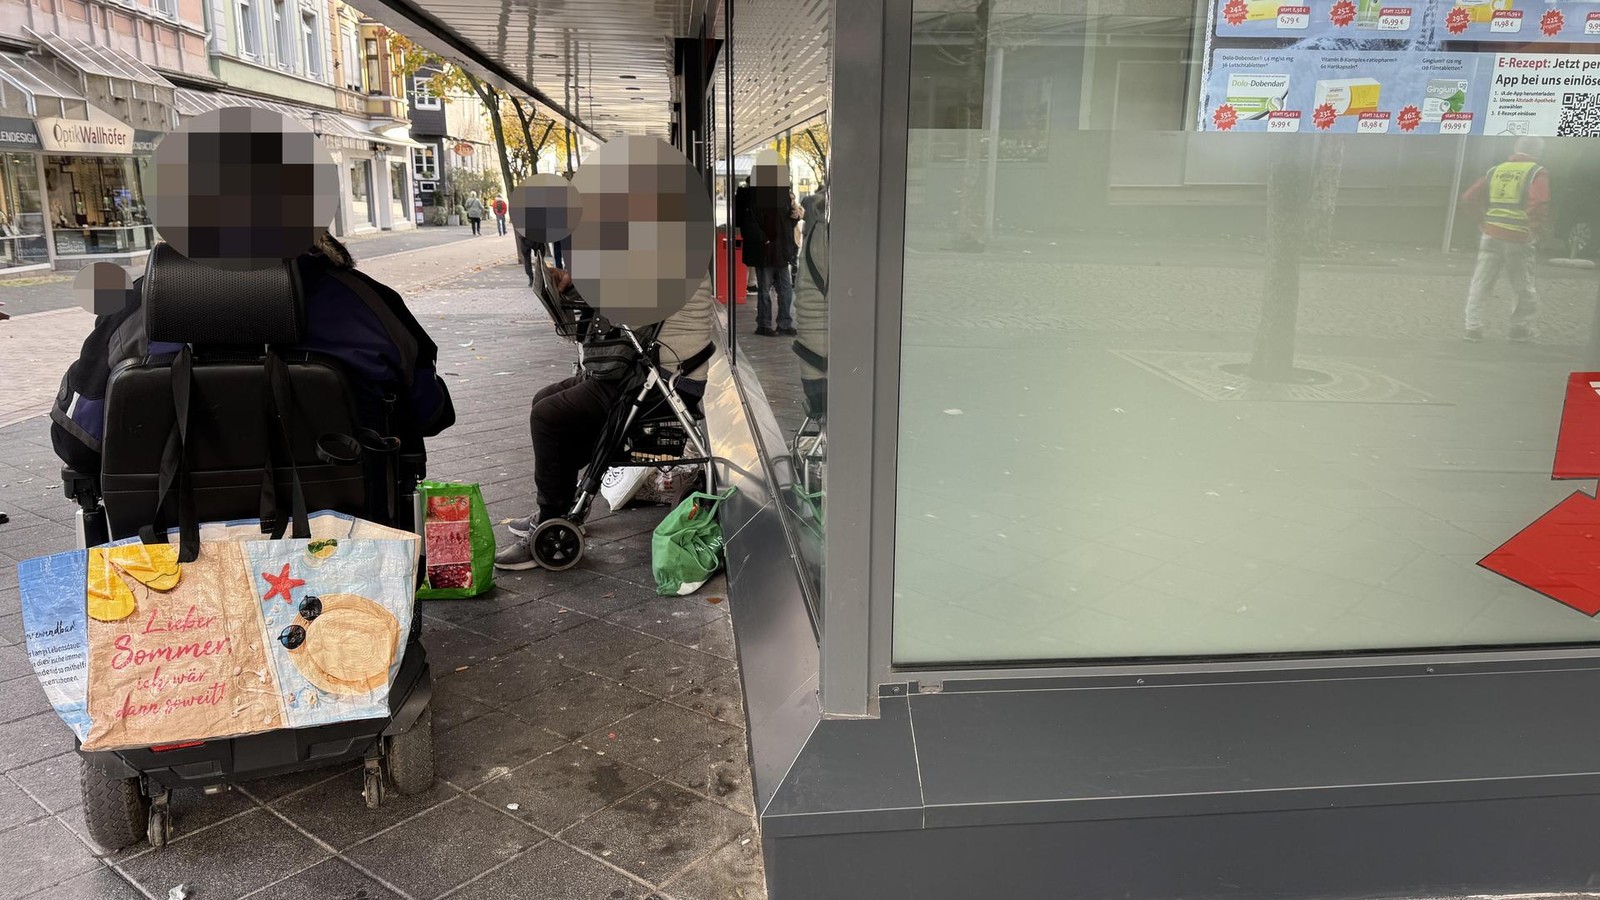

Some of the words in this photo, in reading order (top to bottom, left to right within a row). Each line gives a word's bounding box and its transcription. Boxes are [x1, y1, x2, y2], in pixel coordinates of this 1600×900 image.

[1280, 16, 1295, 24] 6,79
[1498, 57, 1552, 70] E-Rezept:
[1552, 58, 1580, 69] Jetzt
[1496, 74, 1518, 87] App
[1521, 74, 1539, 85] bei
[1542, 77, 1562, 86] uns
[142, 605, 216, 634] Lieber
[112, 634, 232, 670] Sommer,
[137, 666, 168, 691] ich
[174, 668, 208, 684] wär
[115, 694, 160, 720] dann
[165, 682, 226, 714] soweit!
